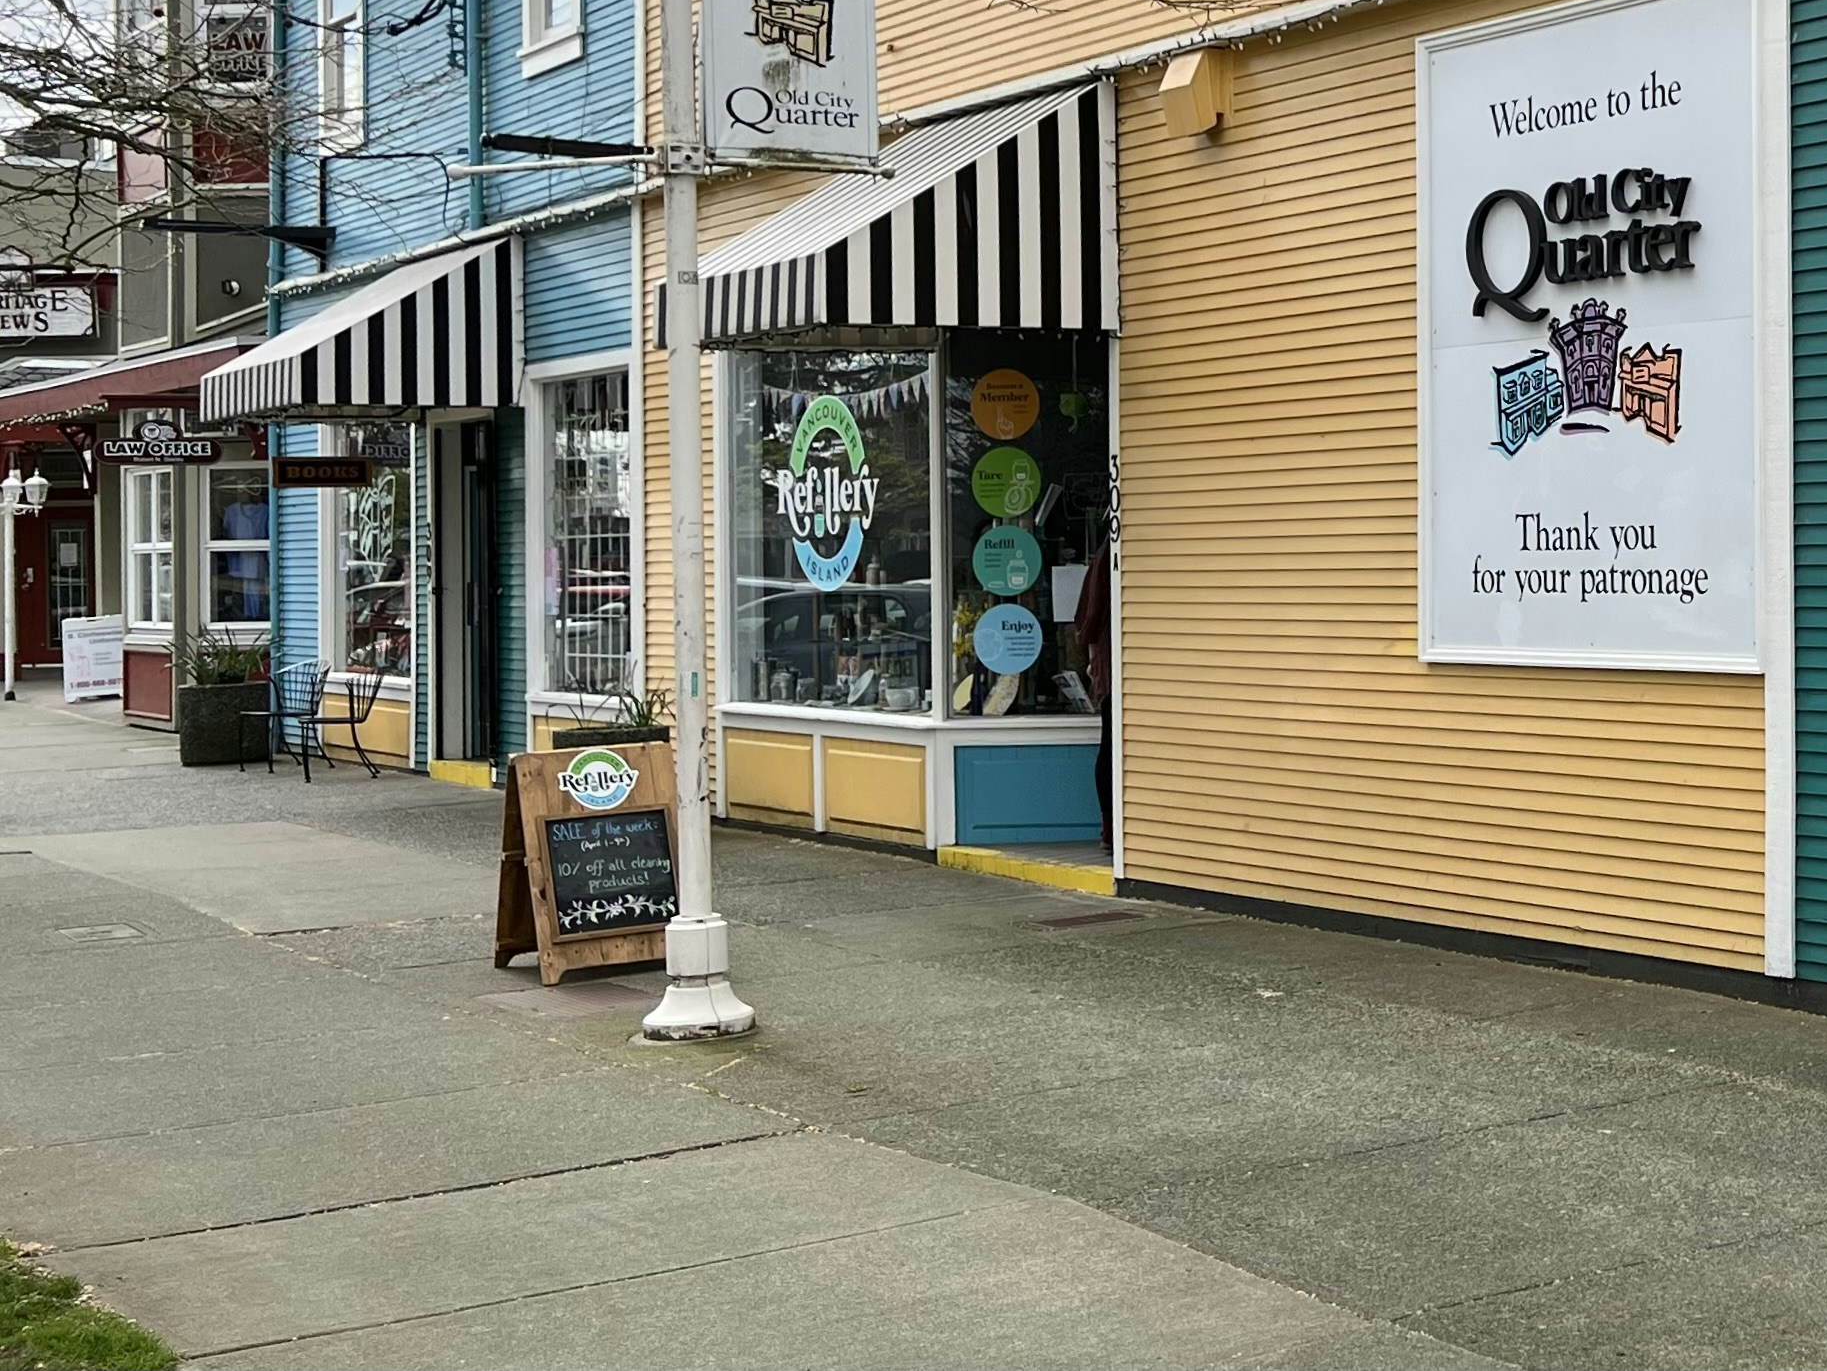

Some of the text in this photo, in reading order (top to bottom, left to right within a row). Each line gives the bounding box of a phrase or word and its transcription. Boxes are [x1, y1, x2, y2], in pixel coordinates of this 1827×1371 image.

[726, 86, 859, 134] Quarter
[775, 89, 854, 110] Old City
[1489, 70, 1682, 138] Welcome to the
[1543, 167, 1692, 225] Old City
[1466, 188, 1702, 323] Quarter
[980, 392, 1030, 402] Member
[796, 404, 858, 453] VANCOUVER
[103, 441, 211, 456] LAW OFFICE
[286, 466, 359, 479] BOOKS
[776, 464, 880, 538] Refillery
[984, 539, 1015, 550] Refill
[1515, 511, 1658, 559] Thank you
[805, 555, 850, 582] ISLAND
[1471, 555, 1709, 604] for your patronage
[1001, 620, 1035, 633] Enjoy
[562, 770, 635, 793] Refillery
[553, 822, 586, 841] SALE
[592, 822, 603, 839] of
[605, 821, 621, 835] the
[558, 855, 671, 877] 10% off all cleaning
[589, 871, 650, 894] products!
